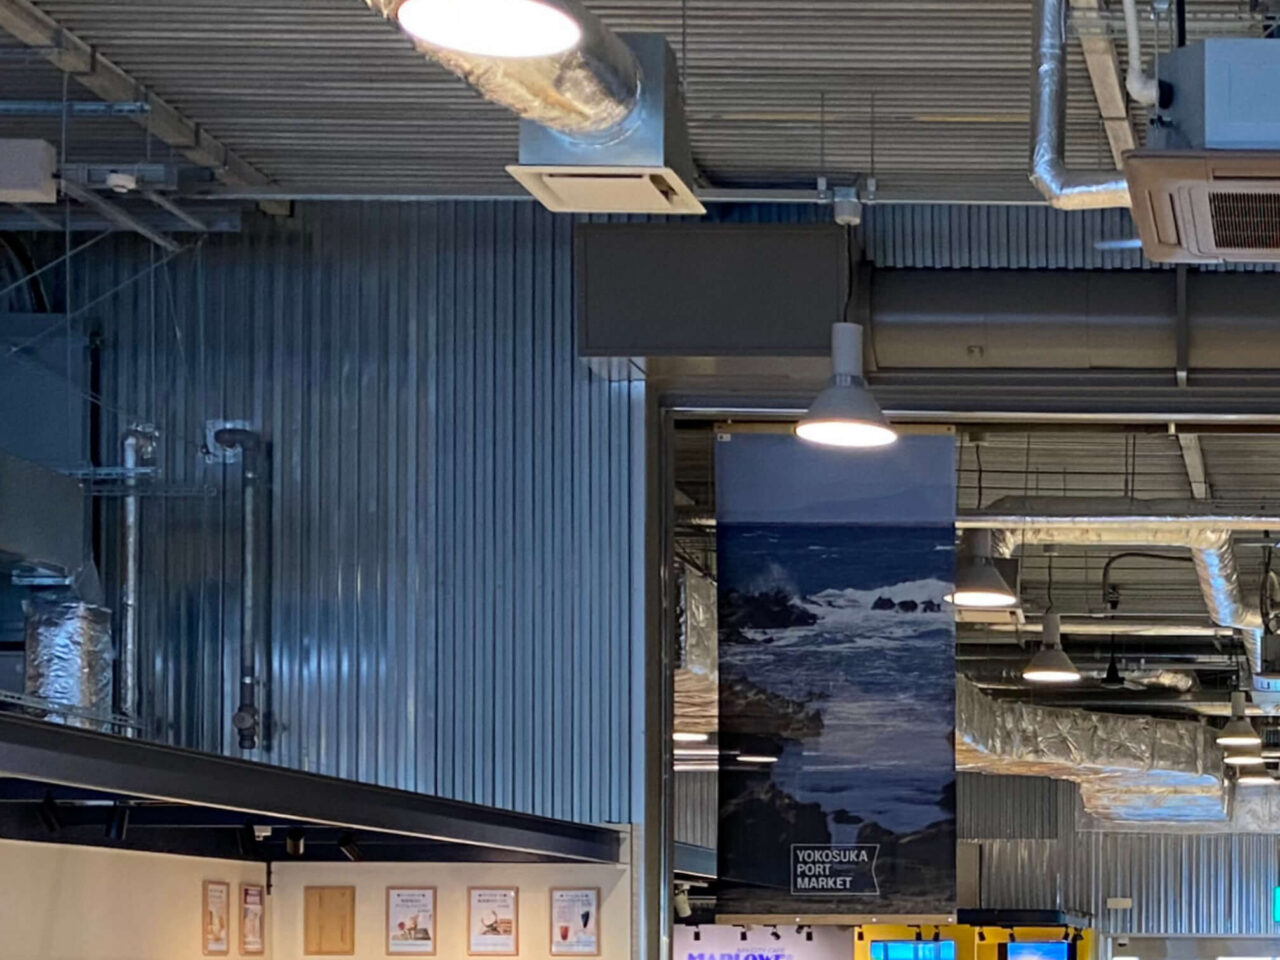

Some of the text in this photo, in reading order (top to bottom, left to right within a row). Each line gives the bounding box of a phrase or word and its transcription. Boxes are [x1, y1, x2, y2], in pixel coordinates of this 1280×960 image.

[796, 850, 868, 862] YOKOSUKA
[796, 863, 832, 876] PORT
[796, 876, 853, 889] MARKET
